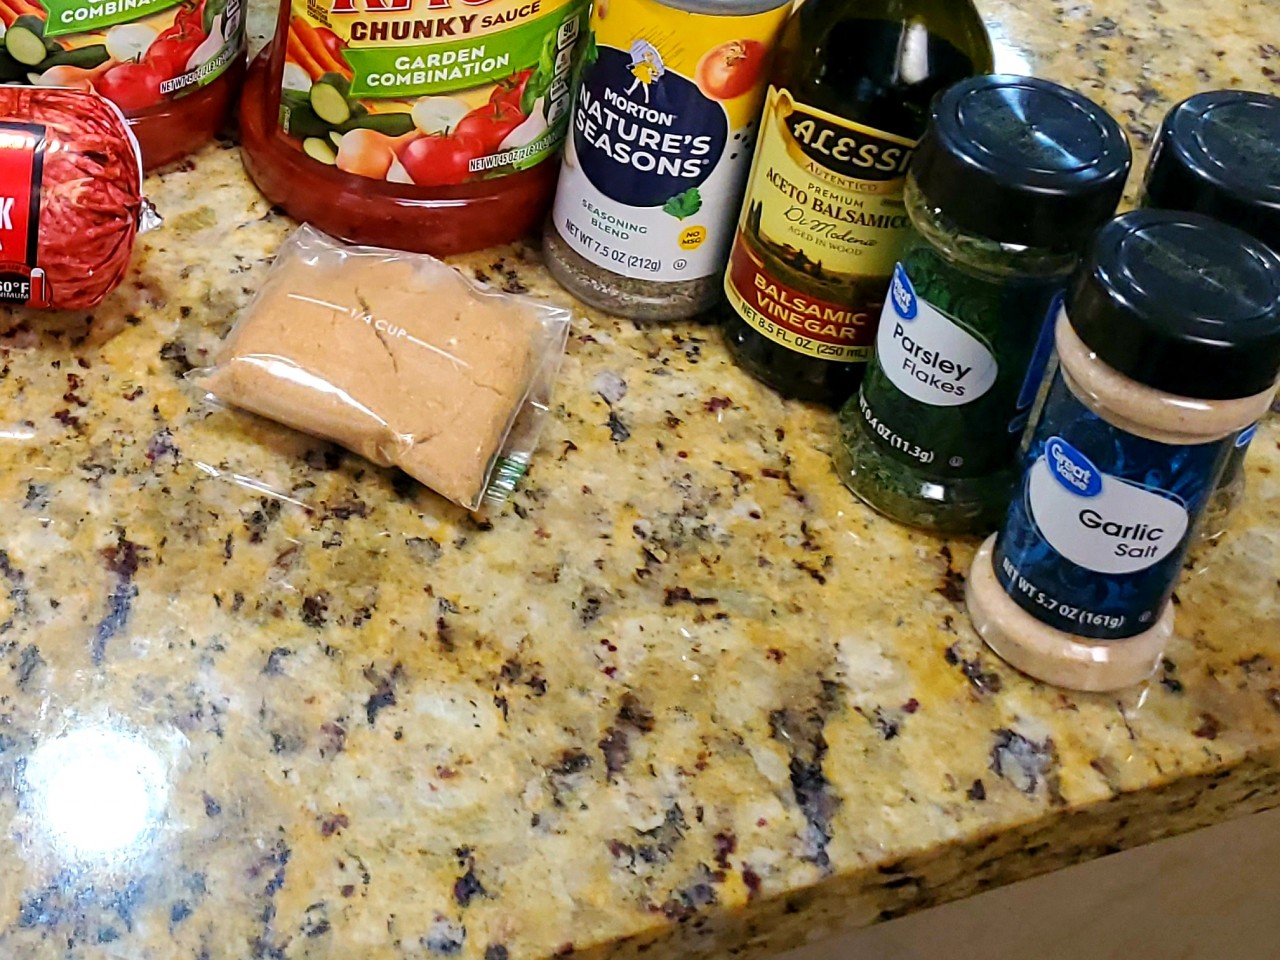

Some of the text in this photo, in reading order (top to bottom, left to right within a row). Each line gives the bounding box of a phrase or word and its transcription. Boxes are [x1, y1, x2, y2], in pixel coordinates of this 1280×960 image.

[350, 12, 479, 42] CHUNKY
[480, 0, 542, 29] SAUCE
[366, 52, 510, 87] COMBINATION
[394, 44, 486, 71] GARDEN
[579, 82, 711, 156] NATURE'S
[604, 87, 674, 126] MORTON
[576, 110, 704, 179] SEASONS
[470, 158, 485, 171] NET
[805, 161, 878, 192] AUTENTICO
[766, 167, 808, 205] ACETO
[807, 182, 864, 208] PREMIUM
[581, 199, 648, 234] SEASONING
[591, 217, 630, 240] BLEND
[686, 230, 700, 238] NO
[565, 218, 662, 272] NET WT 7.5 OZ (212g)
[788, 225, 863, 256] AGED WOOD
[754, 272, 869, 326] BALSAMIC
[757, 290, 856, 340] VINEGAR
[375, 319, 408, 338] CUP
[740, 301, 844, 356] NET 8.5 (250
[892, 321, 972, 382] Parsley
[902, 356, 966, 397] Flakes
[877, 423, 935, 464] OZ (11.3g)
[1051, 443, 1092, 485] Great
[1078, 508, 1165, 542] Garlic
[1114, 542, 1160, 560] Salt
[1002, 556, 1125, 629] NET WT 5.7 OZ (161g)
